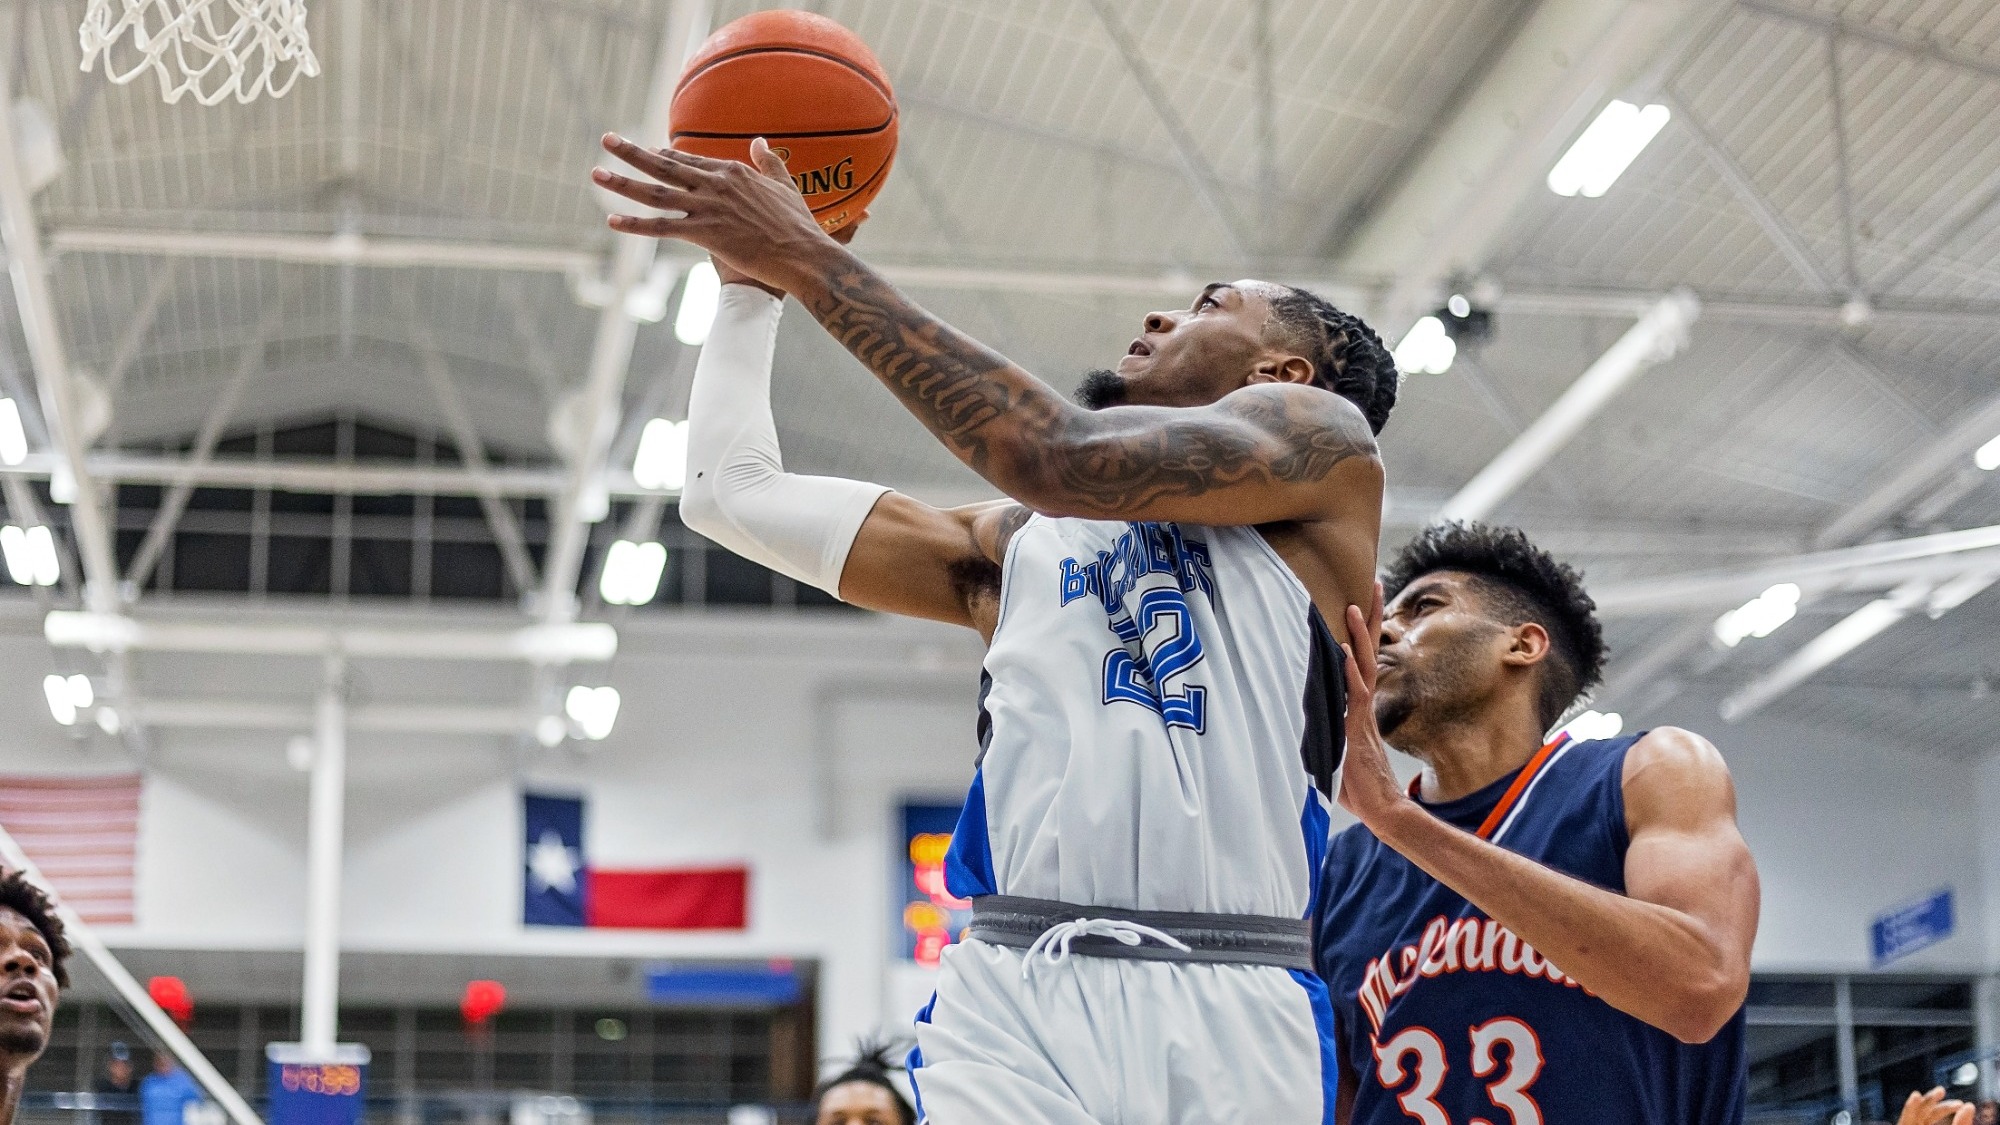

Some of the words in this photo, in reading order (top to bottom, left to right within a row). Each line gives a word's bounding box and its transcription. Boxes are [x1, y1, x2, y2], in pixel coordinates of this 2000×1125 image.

[1102, 586, 1208, 735] 22
[1358, 914, 1598, 1042] McLenna
[1370, 1015, 1547, 1125] 33
